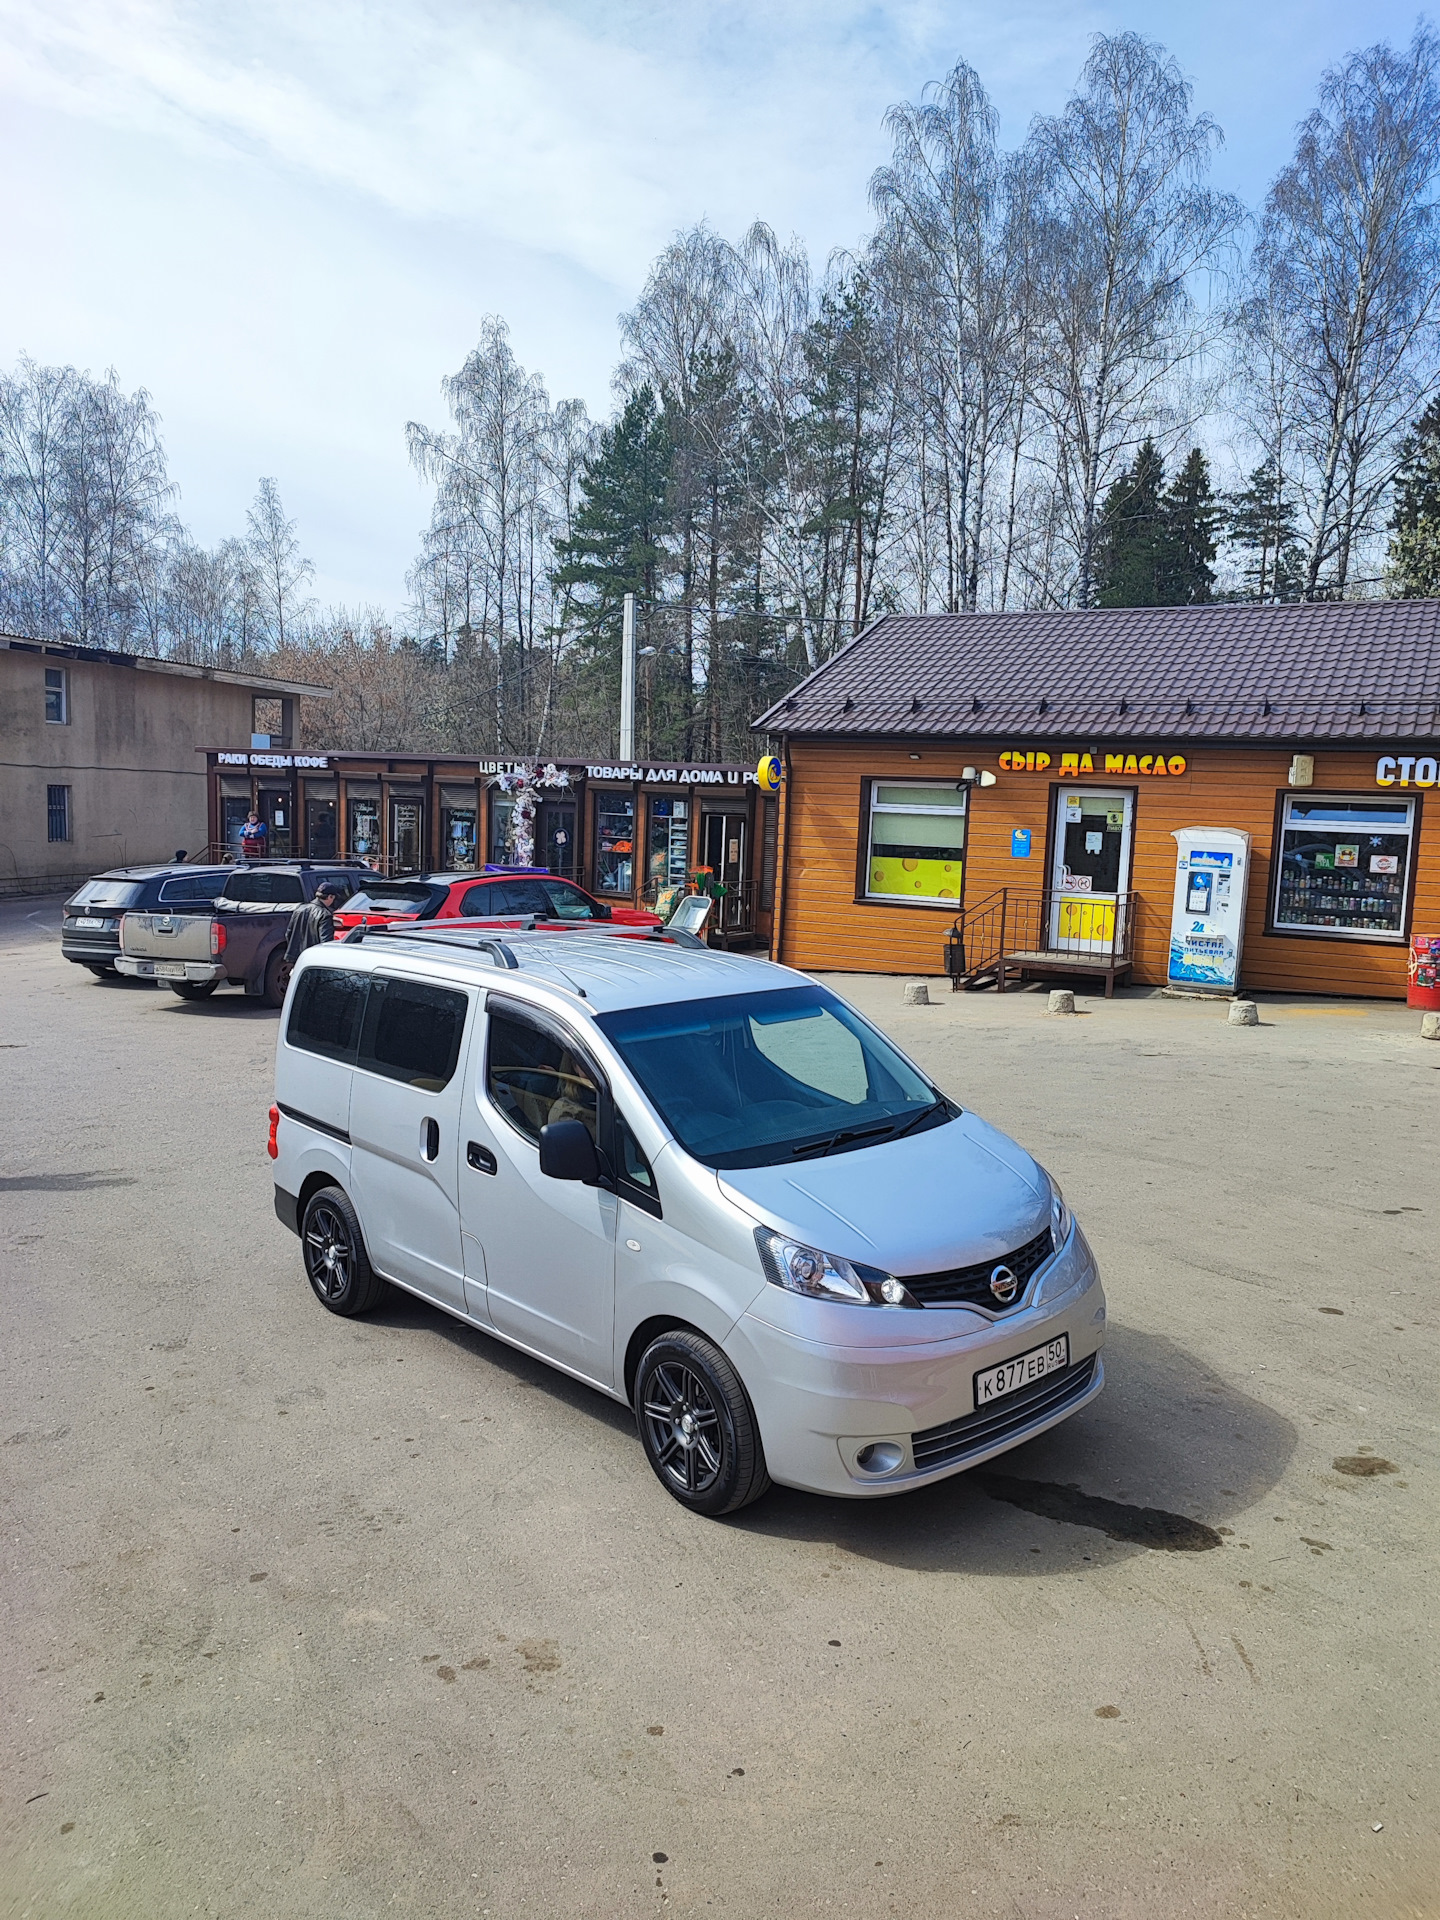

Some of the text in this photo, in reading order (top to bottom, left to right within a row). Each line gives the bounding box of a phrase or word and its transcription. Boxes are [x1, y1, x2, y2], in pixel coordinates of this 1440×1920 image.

[218, 752, 328, 768] РАКИ ОБЕДЫ КОФЕ
[999, 751, 1187, 777] СЫР ДА МАСЛО
[585, 765, 643, 781] ТОВАРЫ
[646, 768, 677, 783] ДЛЯ
[679, 769, 723, 785] ДОМА
[1376, 756, 1440, 788] СТО
[995, 1276, 1017, 1291] NISSAN
[1048, 1341, 1062, 1361] 50
